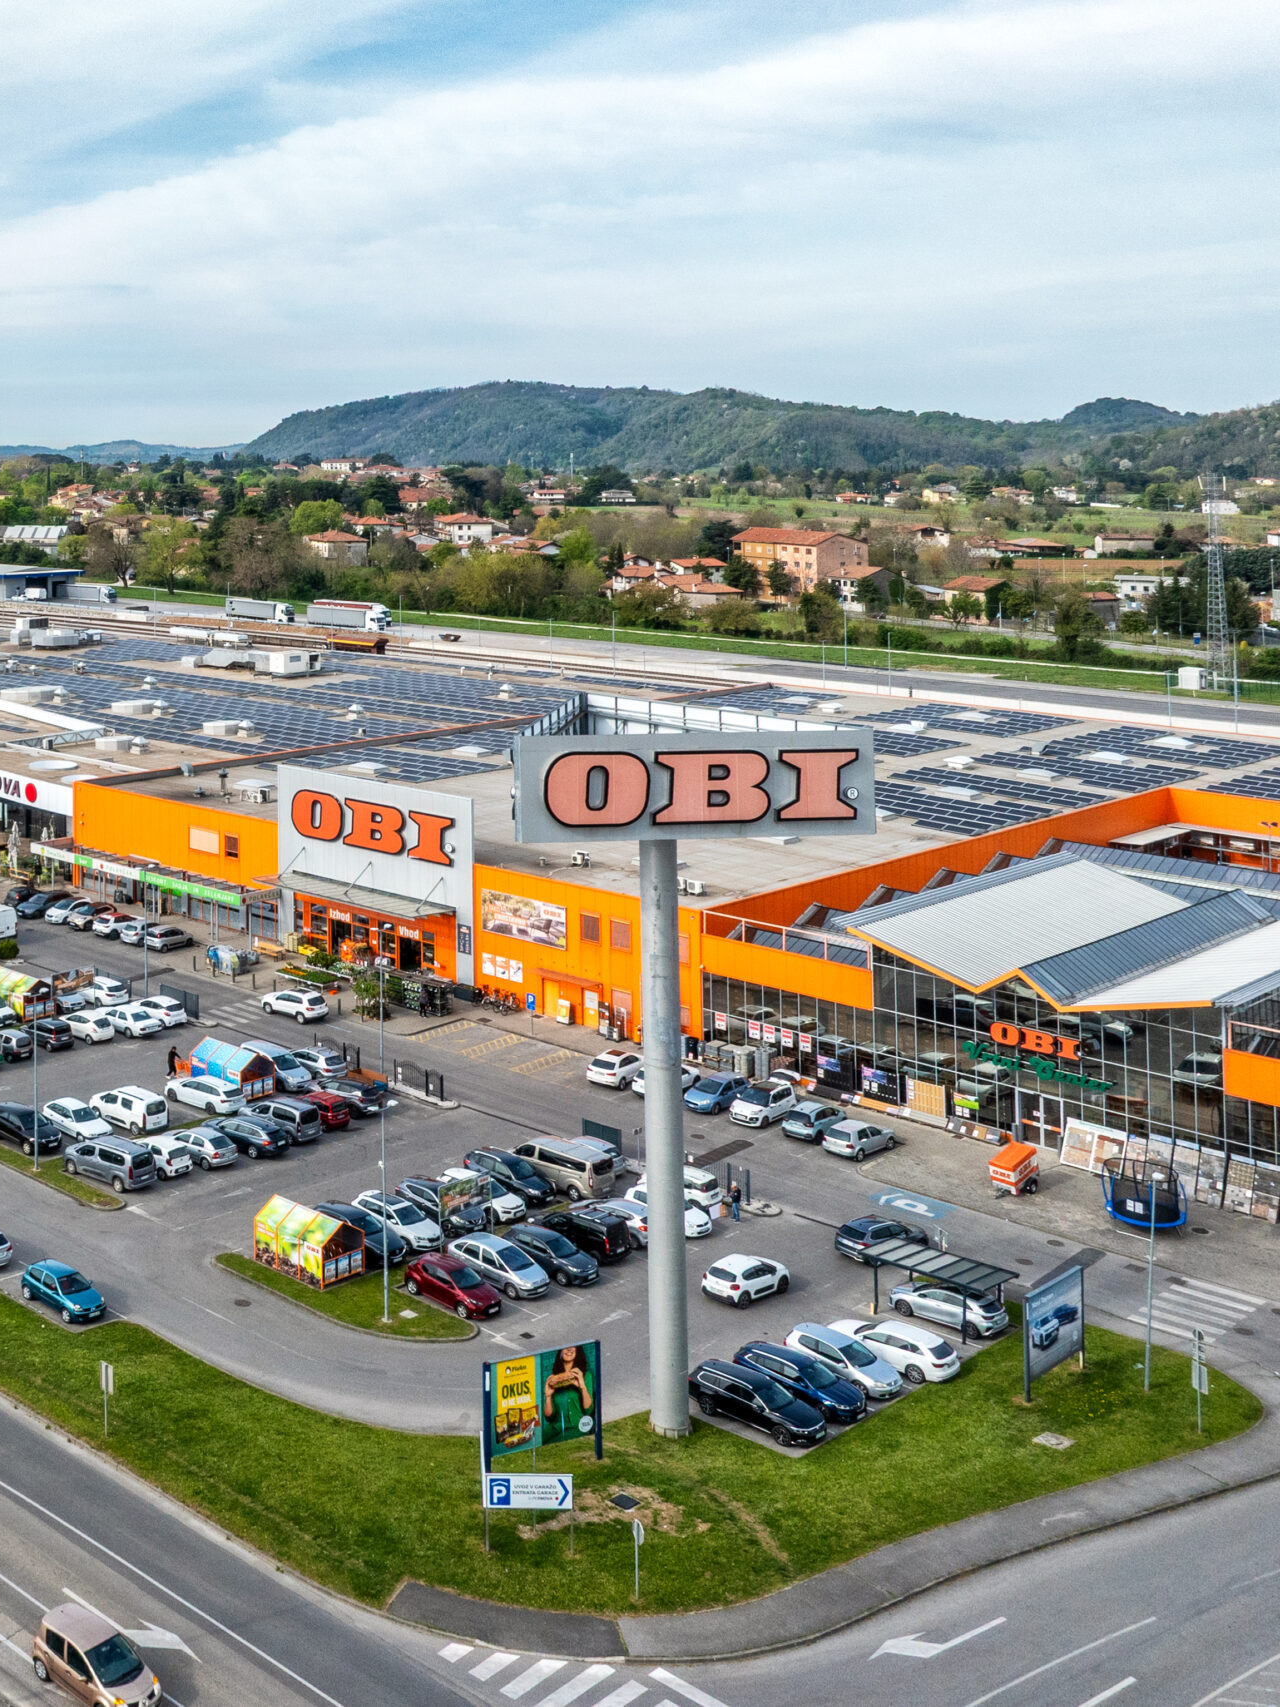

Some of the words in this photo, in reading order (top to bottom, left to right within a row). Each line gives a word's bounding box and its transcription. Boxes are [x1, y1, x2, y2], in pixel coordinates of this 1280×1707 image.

[543, 748, 859, 827] OBI
[291, 789, 455, 867] OBI
[329, 908, 350, 922] Izhod
[399, 925, 419, 939] Vhod
[962, 1040, 1021, 1071] Vrtni
[989, 1021, 1080, 1061] OBI
[992, 1168, 1012, 1180] OBI
